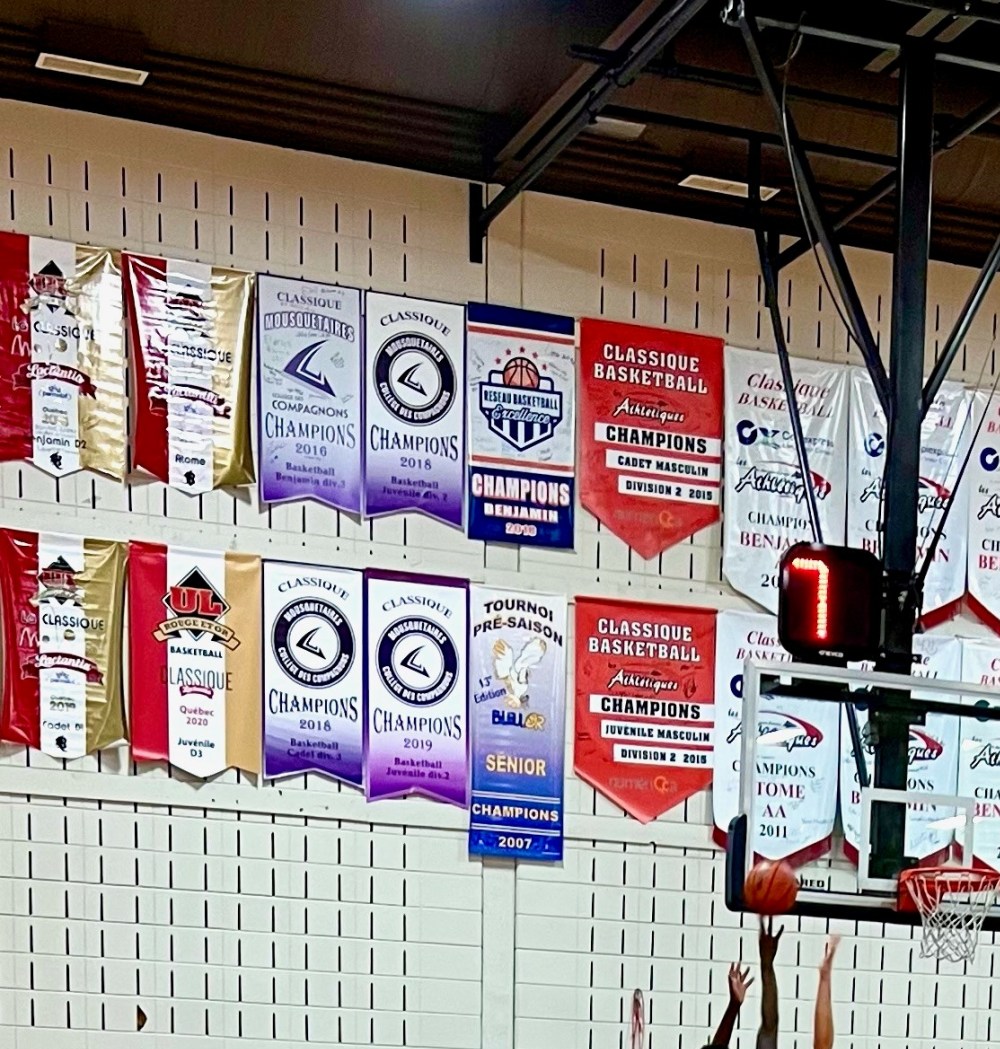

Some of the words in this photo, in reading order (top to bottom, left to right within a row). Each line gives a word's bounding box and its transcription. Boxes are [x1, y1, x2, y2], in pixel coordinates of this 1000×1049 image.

[277, 292, 341, 310] CLASSIQUE
[264, 311, 355, 342] MOUSQUETAIRES
[380, 311, 450, 336] CLASSIQUE
[604, 344, 699, 373] CLASSIQUE
[594, 364, 708, 394] BASKETBALL
[272, 400, 348, 418] COMPAGNONS
[512, 393, 558, 410] BASKETBALL
[491, 406, 551, 425] Excellence
[265, 413, 356, 449] CHAMPIONS
[606, 426, 707, 454] CHAMPIONS
[370, 425, 458, 461] CHAMPIONS
[286, 462, 335, 476] Basketball
[400, 457, 432, 470] 2018
[618, 456, 652, 469] CADET
[655, 461, 709, 476] MASCULIN
[276, 472, 320, 486] Benjamin
[391, 476, 439, 489] Basketball
[472, 474, 570, 507] CHAMPIONS
[626, 480, 672, 496] DIVISION
[674, 487, 682, 497] 2
[689, 488, 713, 500] 2015
[484, 503, 558, 523] BENJAMIN
[278, 577, 349, 600] CLASSIQUE
[792, 558, 829, 639] 7
[170, 587, 223, 615] UL
[382, 596, 453, 619] CLASSIQUE
[484, 600, 553, 622] TOURNOI
[42, 614, 104, 630] CLASSIQUE
[165, 618, 198, 632] ROUGE
[199, 619, 211, 631] ET
[213, 623, 229, 638] OR
[473, 615, 563, 647] PRÉ-SAISON
[597, 618, 692, 642] CLASSIQUE
[170, 646, 223, 659] BASKETBALL
[589, 637, 700, 662] BASKETBALL
[180, 705, 214, 716] Québec
[269, 689, 358, 722] CHAMPIONS
[601, 697, 700, 719] CHAMPIONS
[186, 717, 208, 726] 2020
[299, 720, 331, 731] 2018
[373, 708, 462, 741] CHAMPIONS
[178, 737, 215, 749] Juvénile
[290, 738, 339, 750] Basketball
[404, 739, 432, 751] 2019
[657, 729, 710, 741] MASCULIN
[394, 757, 442, 769] Basketball
[486, 754, 545, 777] SÉNIOR
[621, 749, 666, 760] DIVISION
[670, 753, 675, 762] 2
[472, 803, 559, 823] CHAMPIONS
[762, 805, 786, 818] AA
[759, 825, 787, 838] 2011
[499, 836, 532, 849] 2007
